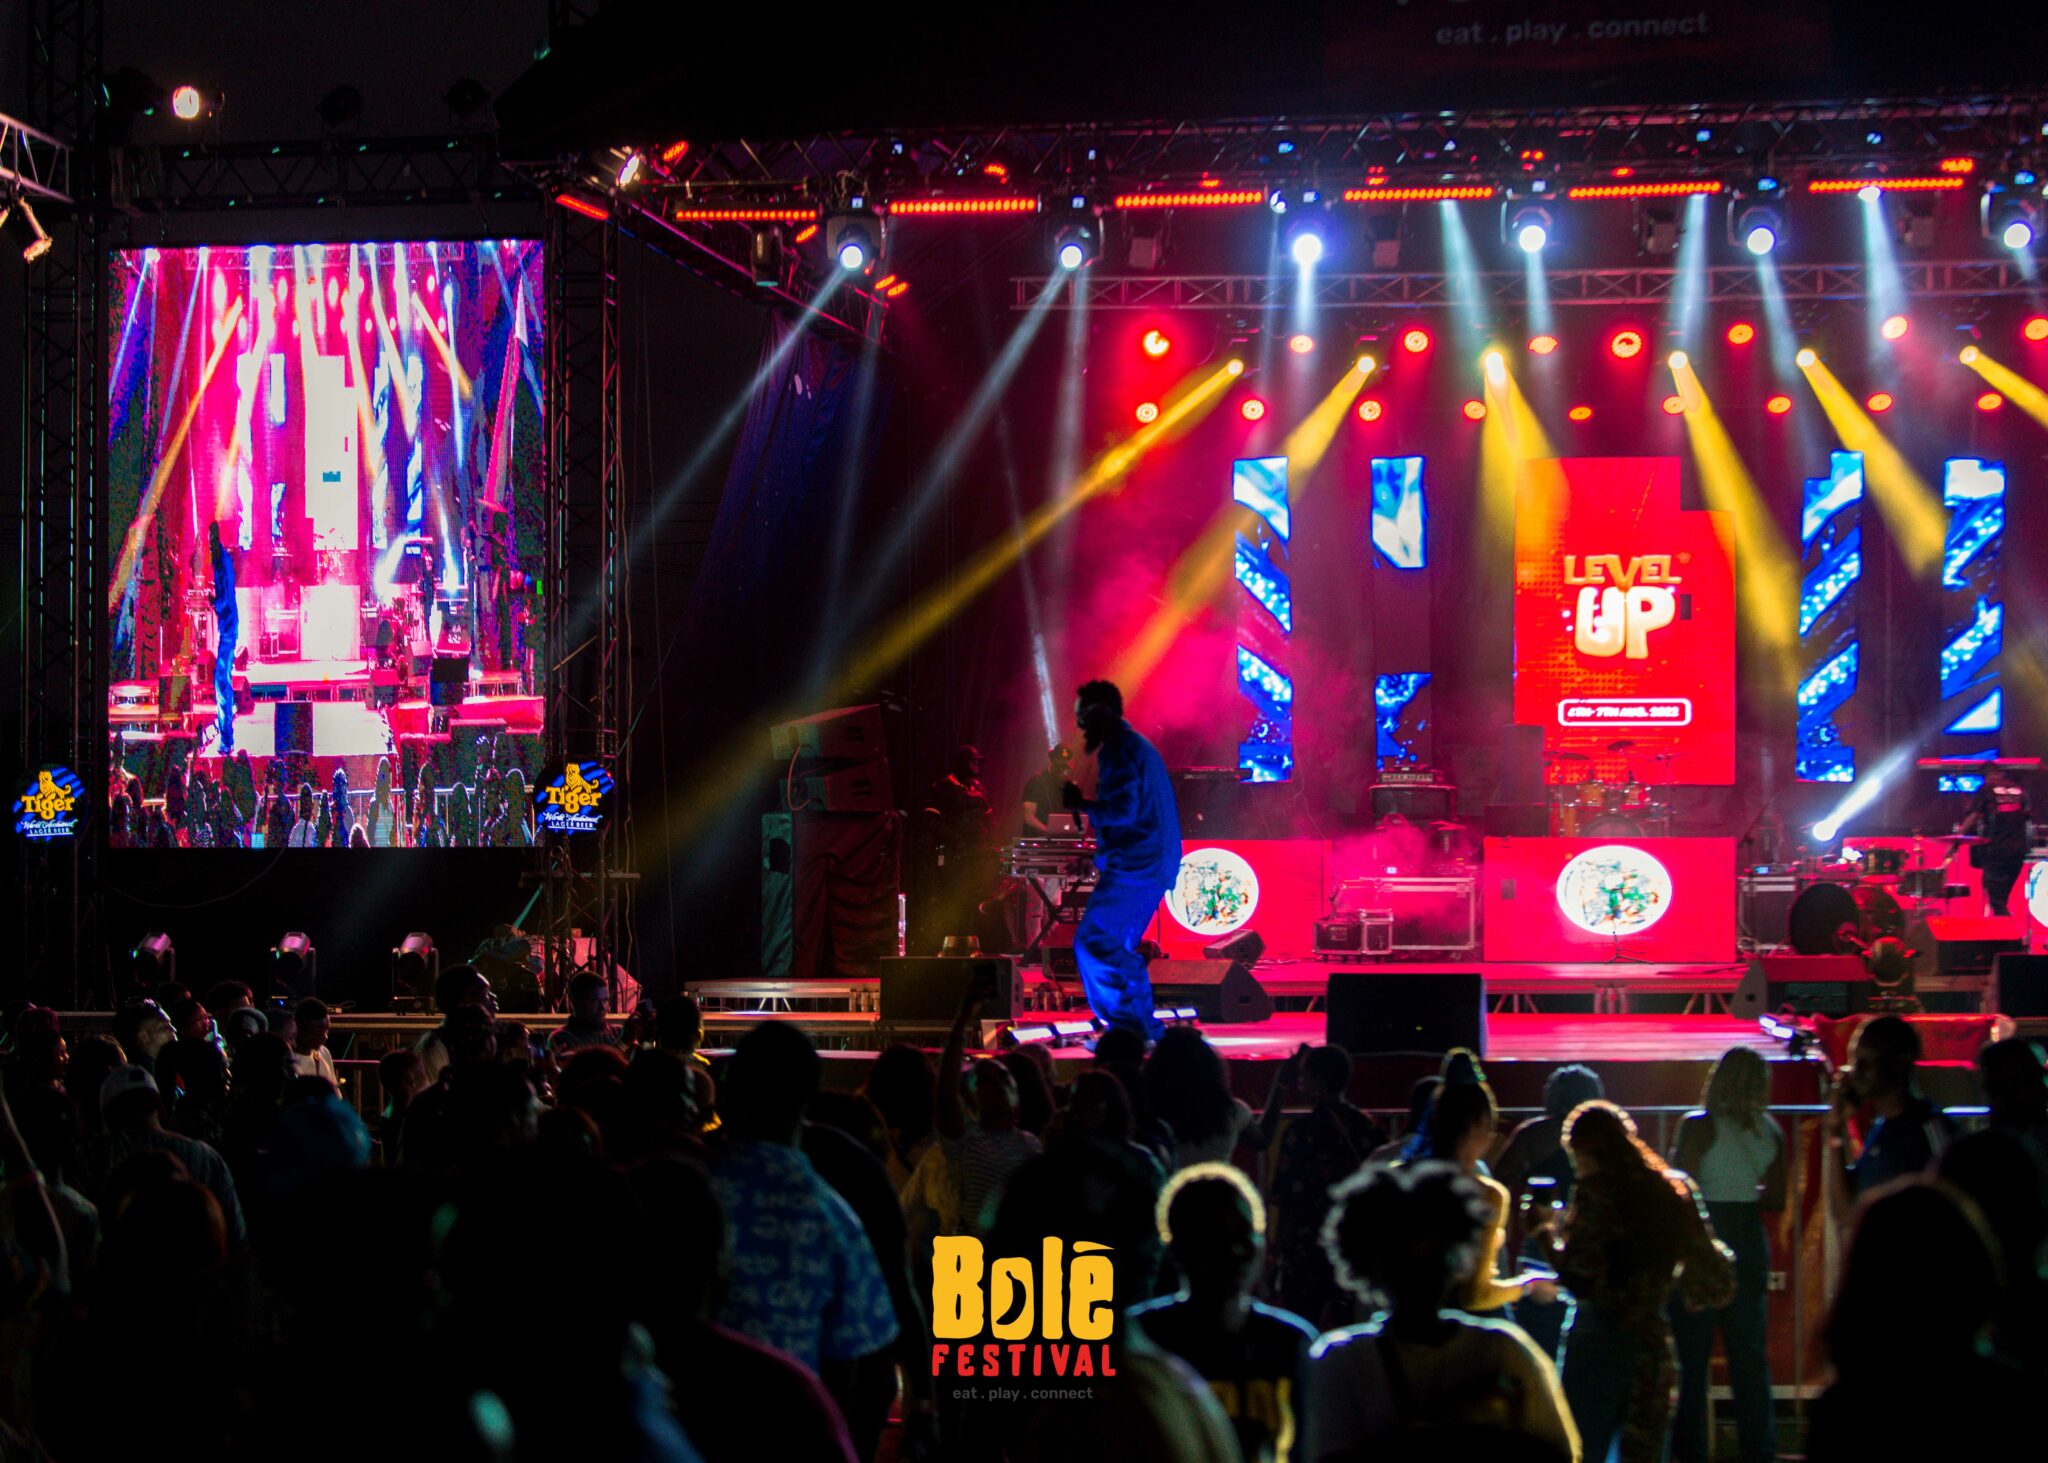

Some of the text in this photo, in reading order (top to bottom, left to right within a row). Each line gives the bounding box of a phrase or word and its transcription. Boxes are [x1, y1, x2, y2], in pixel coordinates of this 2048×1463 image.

[1436, 12, 1708, 48] eat play connect
[1564, 554, 1682, 593] LEVEL
[1575, 586, 1676, 659] UP
[21, 793, 75, 820] Tiger
[545, 785, 602, 813] Tiger
